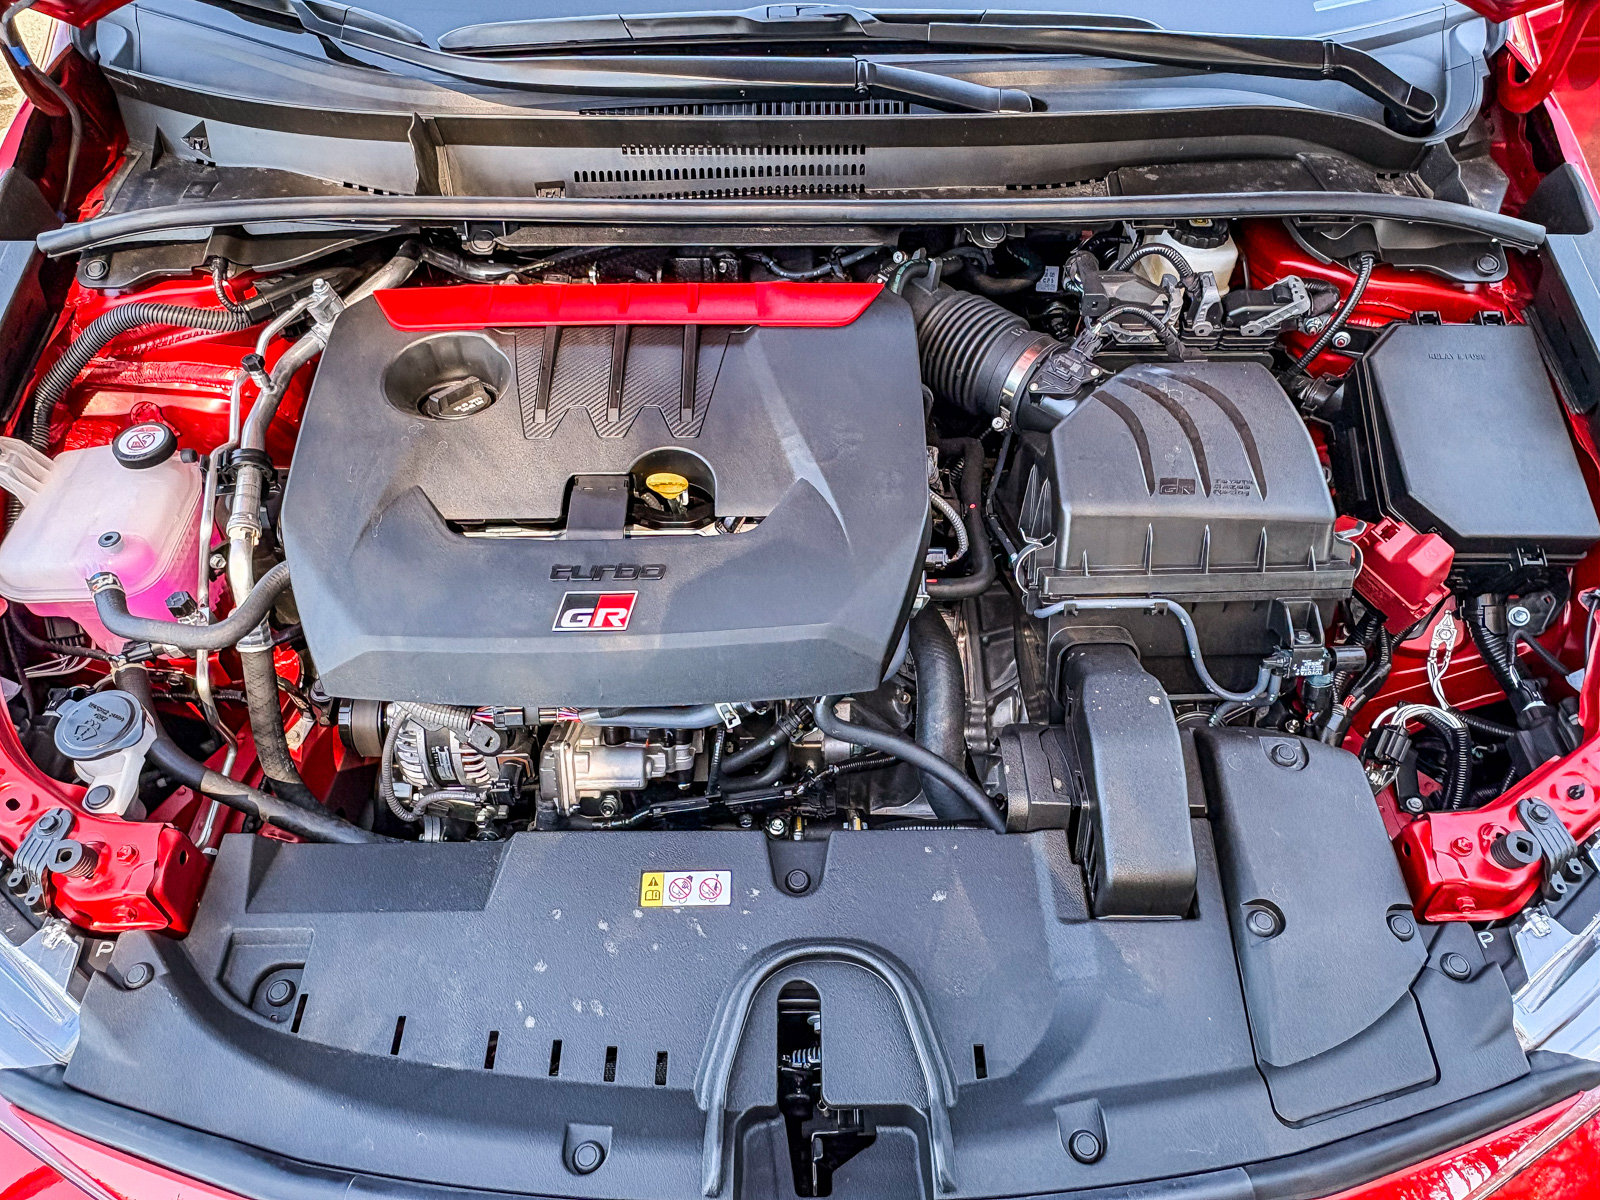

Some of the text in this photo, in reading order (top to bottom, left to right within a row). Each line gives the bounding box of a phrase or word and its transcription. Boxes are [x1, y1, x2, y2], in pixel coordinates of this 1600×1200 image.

[1427, 352, 1454, 361] RELAY
[549, 563, 667, 582] turbo
[560, 607, 629, 628] GR
[1477, 931, 1494, 949] P
[95, 941, 114, 958] P
